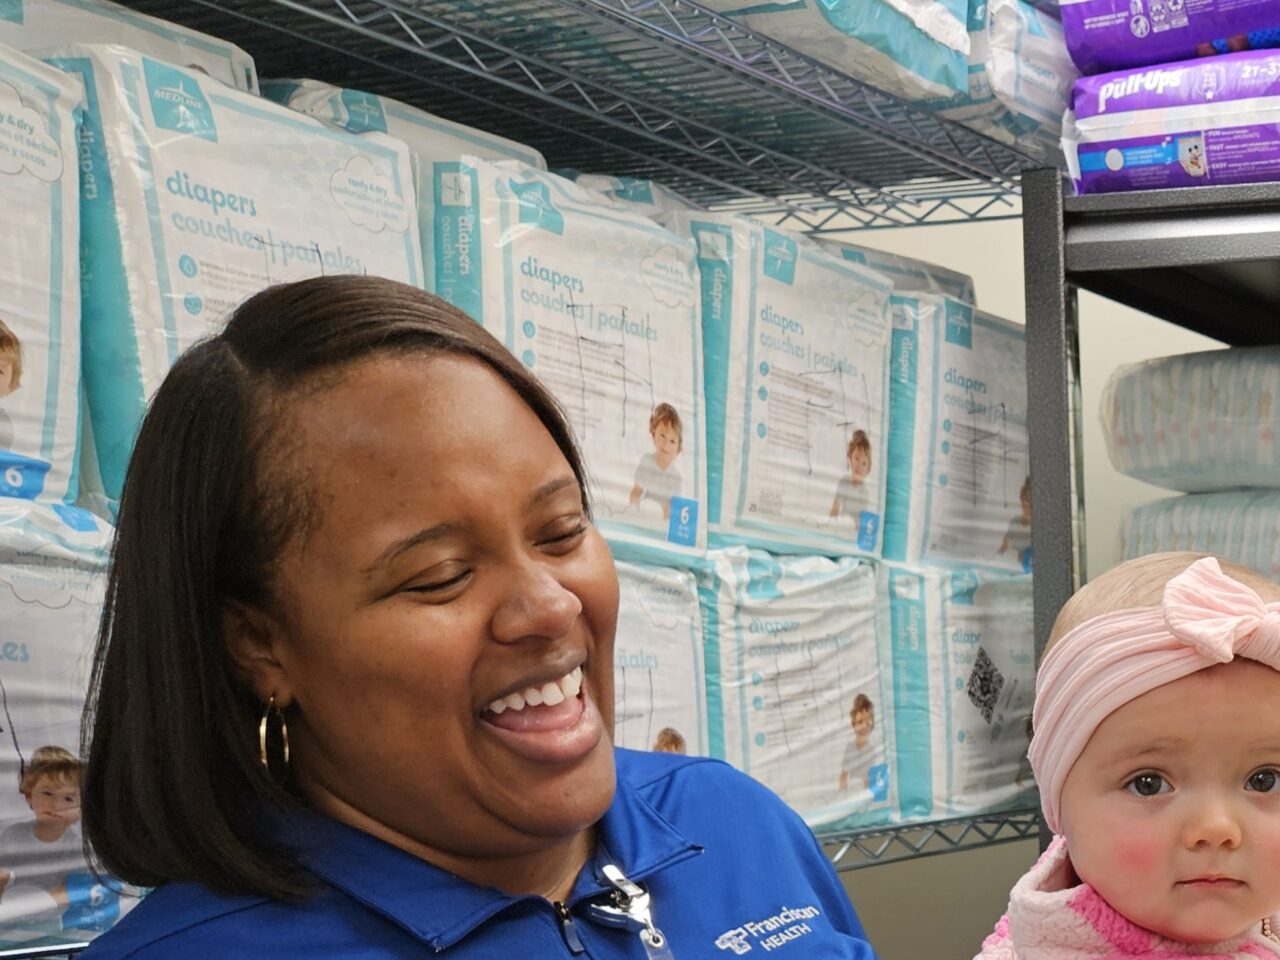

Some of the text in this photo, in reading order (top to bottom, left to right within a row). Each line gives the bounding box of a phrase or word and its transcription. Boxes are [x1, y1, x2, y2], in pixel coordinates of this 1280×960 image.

[153, 88, 204, 109] MEDLINE
[1098, 67, 1183, 113] Pull-Ups
[77, 125, 98, 200] diapers
[166, 170, 257, 216] diapers
[172, 211, 362, 275] couches pañales
[456, 215, 471, 276] diapers
[520, 256, 584, 292] diapers
[521, 287, 658, 342] couches pañales
[760, 304, 804, 336] diapers
[760, 333, 805, 360] couches
[944, 369, 987, 395] diapers
[5, 466, 23, 488] 6
[681, 505, 690, 525] 6
[748, 904, 820, 937] Franciscan
[760, 923, 812, 951] HEALTH
